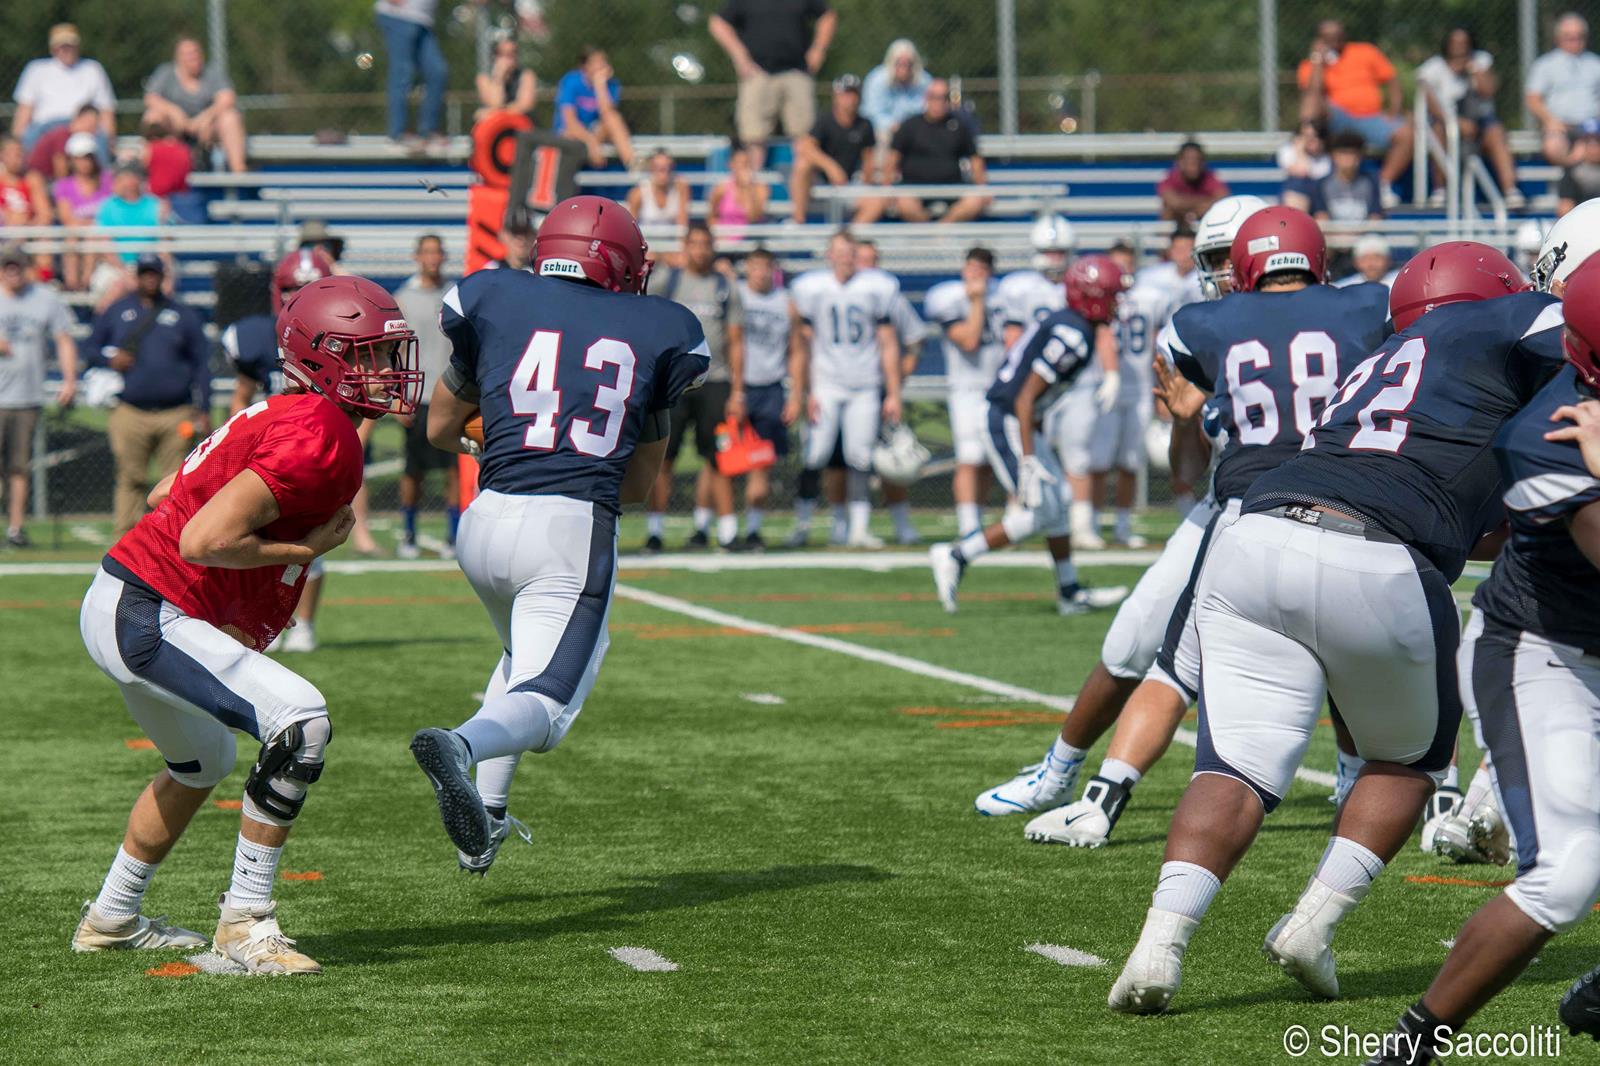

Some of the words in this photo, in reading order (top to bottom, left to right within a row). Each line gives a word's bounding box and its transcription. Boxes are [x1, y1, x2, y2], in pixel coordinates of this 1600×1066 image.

[527, 145, 562, 208] 1
[544, 262, 578, 273] schutt
[1271, 256, 1305, 266] schutt
[509, 328, 637, 458] 43
[1225, 330, 1340, 445] 68
